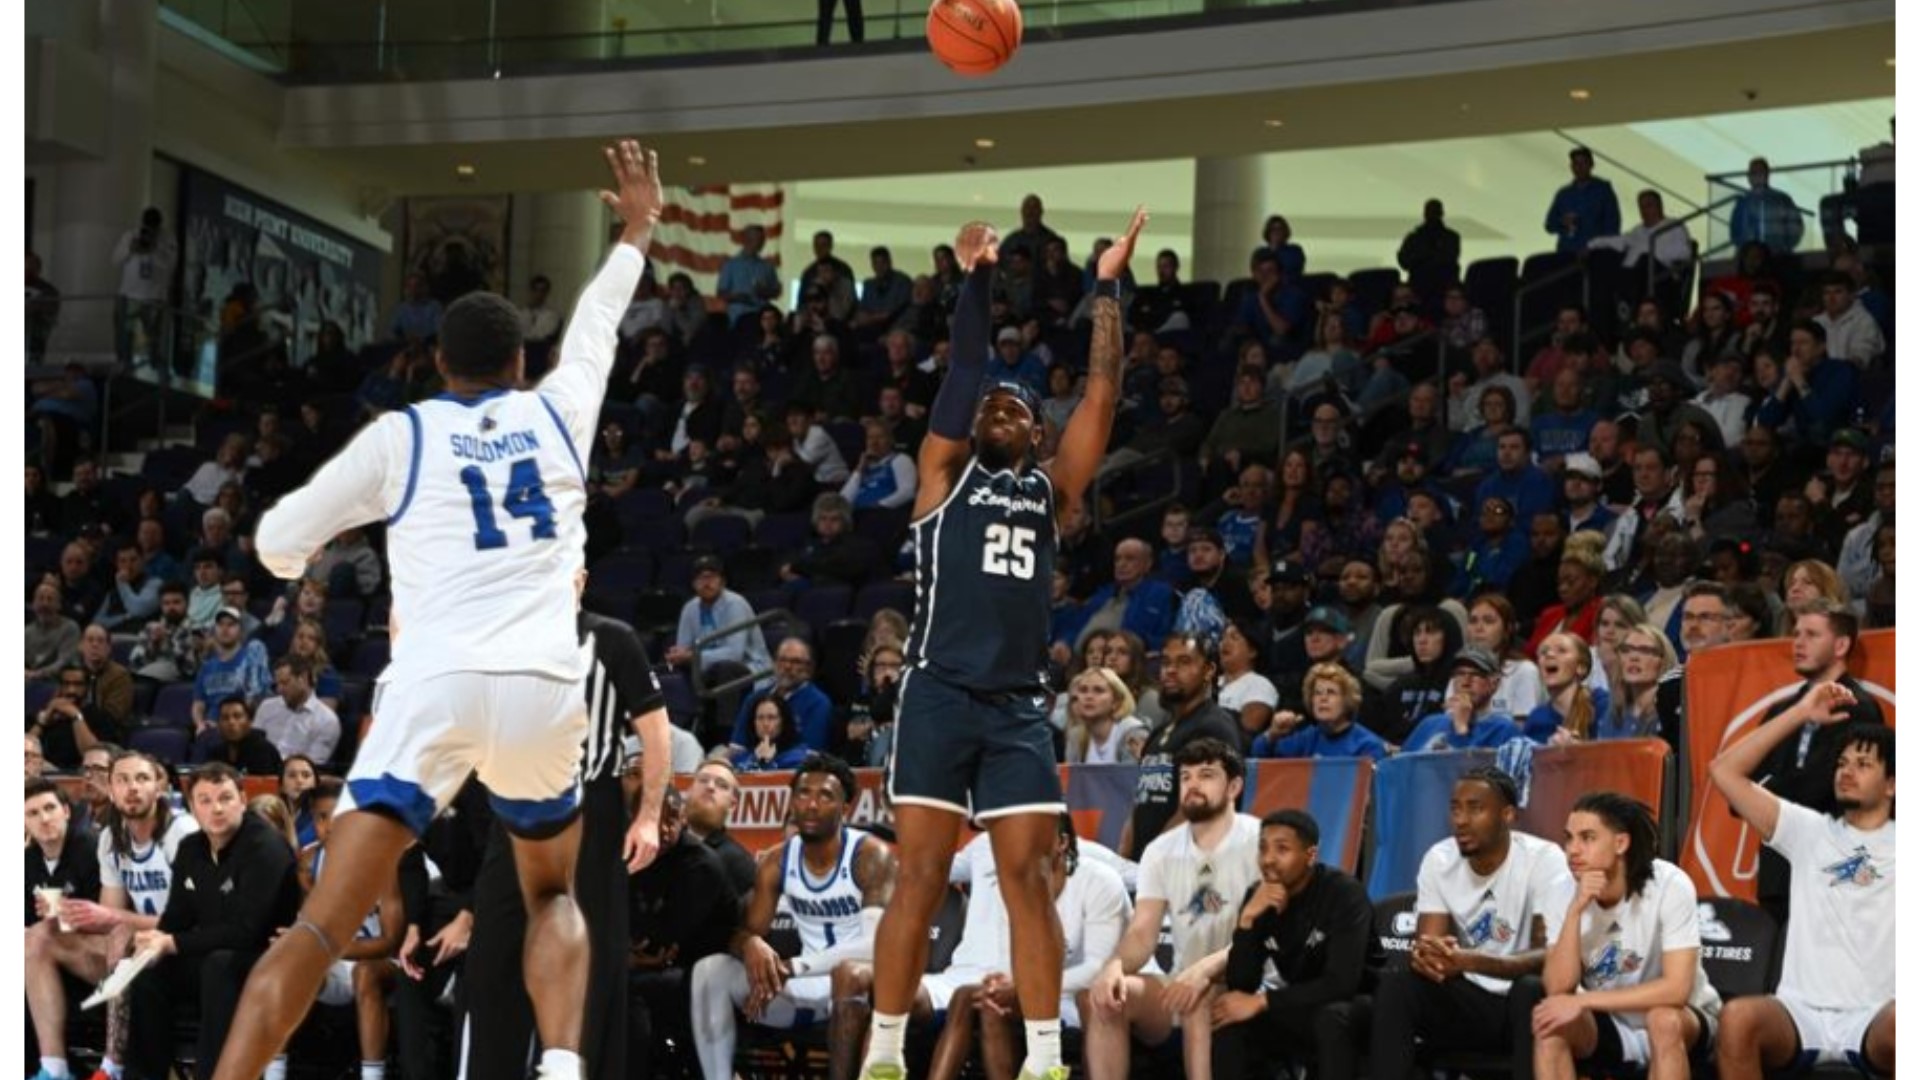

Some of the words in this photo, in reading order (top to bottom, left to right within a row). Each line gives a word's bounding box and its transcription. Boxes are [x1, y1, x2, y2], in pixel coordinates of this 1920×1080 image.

[450, 429, 541, 463] SOLOMON
[459, 457, 559, 552] 14
[981, 522, 1037, 580] 25
[1715, 946, 1752, 961] TIRES
